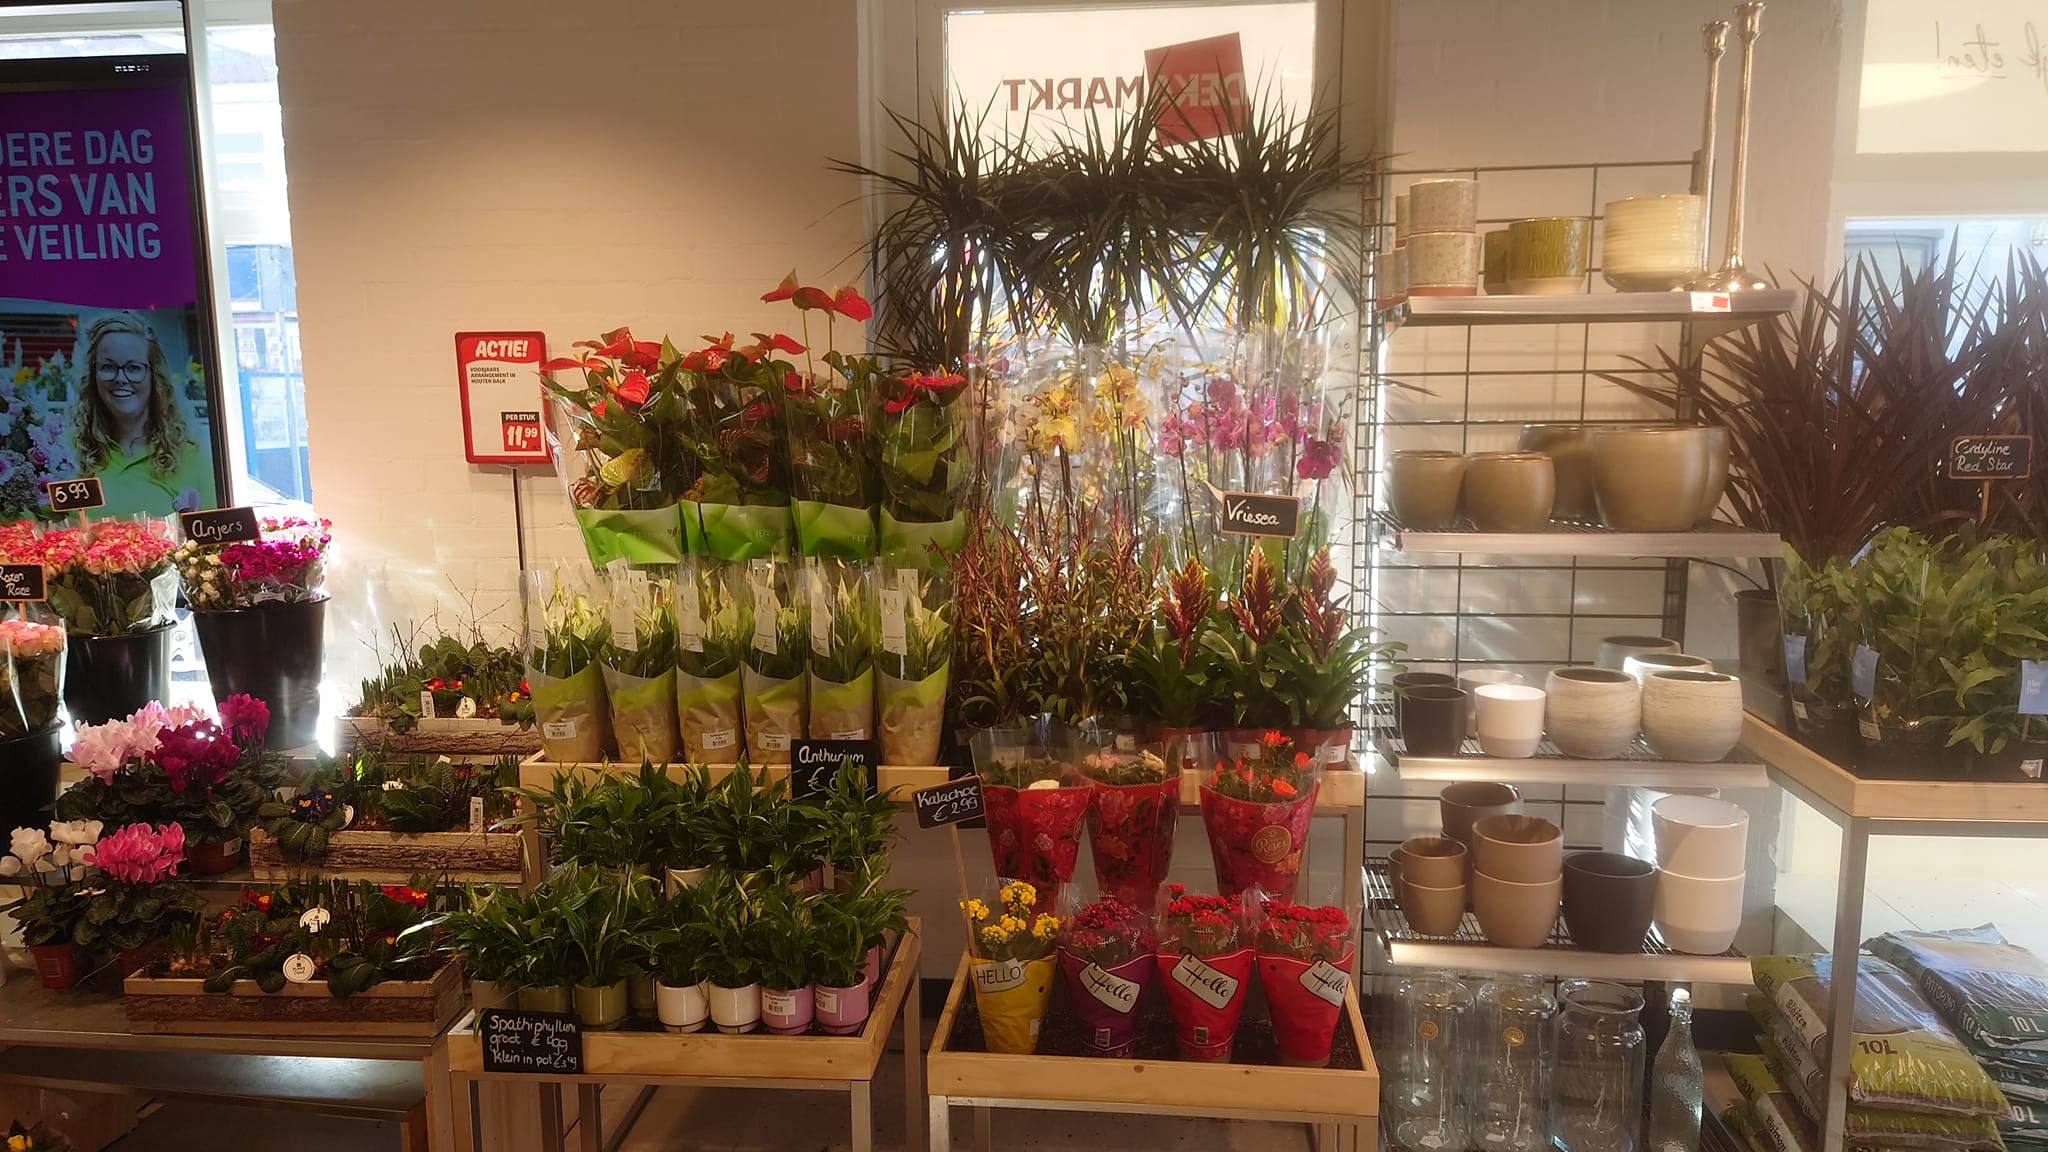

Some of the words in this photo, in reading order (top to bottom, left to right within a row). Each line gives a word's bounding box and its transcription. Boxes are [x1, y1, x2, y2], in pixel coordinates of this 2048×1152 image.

[0, 132, 75, 167] ERE
[84, 129, 154, 165] DAG
[70, 172, 156, 215] VAN
[14, 222, 161, 260] VEILING
[475, 340, 529, 358] ACTIE!
[1956, 455, 1982, 472] Red
[1987, 457, 2014, 471] Star
[976, 966, 1021, 985] HELLO
[1087, 971, 1133, 1002] Hello
[1182, 964, 1230, 998] Hello
[1312, 969, 1345, 994] Hello
[1859, 1039, 1898, 1055] 10L
